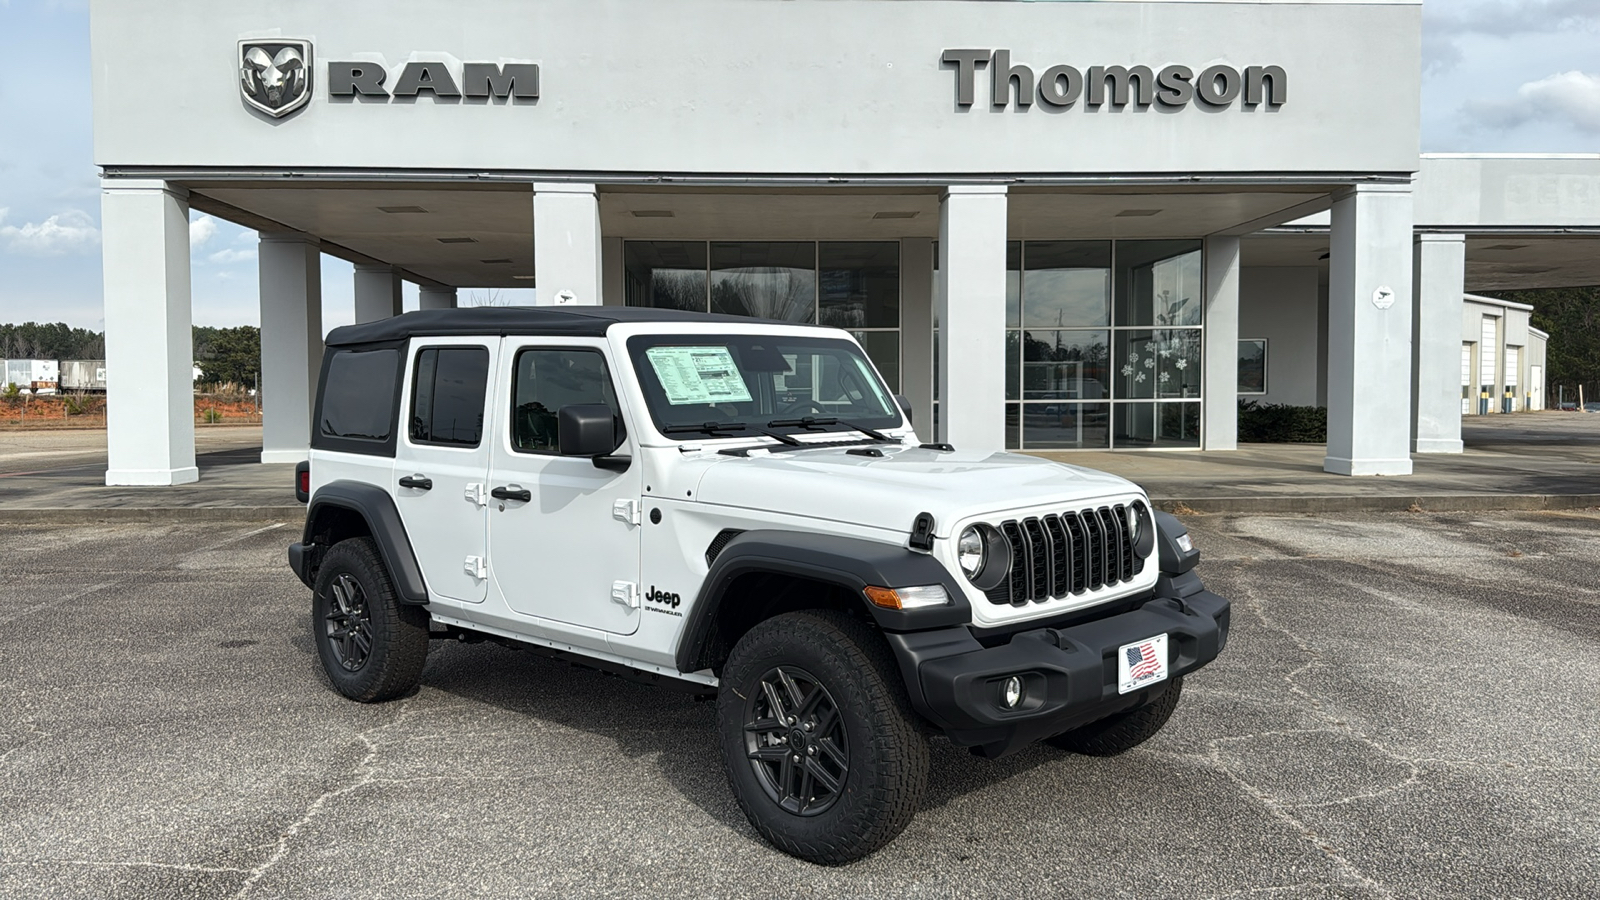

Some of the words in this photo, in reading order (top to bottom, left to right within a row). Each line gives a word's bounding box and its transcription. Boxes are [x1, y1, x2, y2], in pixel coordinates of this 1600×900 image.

[328, 61, 540, 99] RAM
[941, 48, 1288, 107] Thomson
[645, 585, 681, 609] Jeep
[651, 607, 683, 617] WRANGLER
